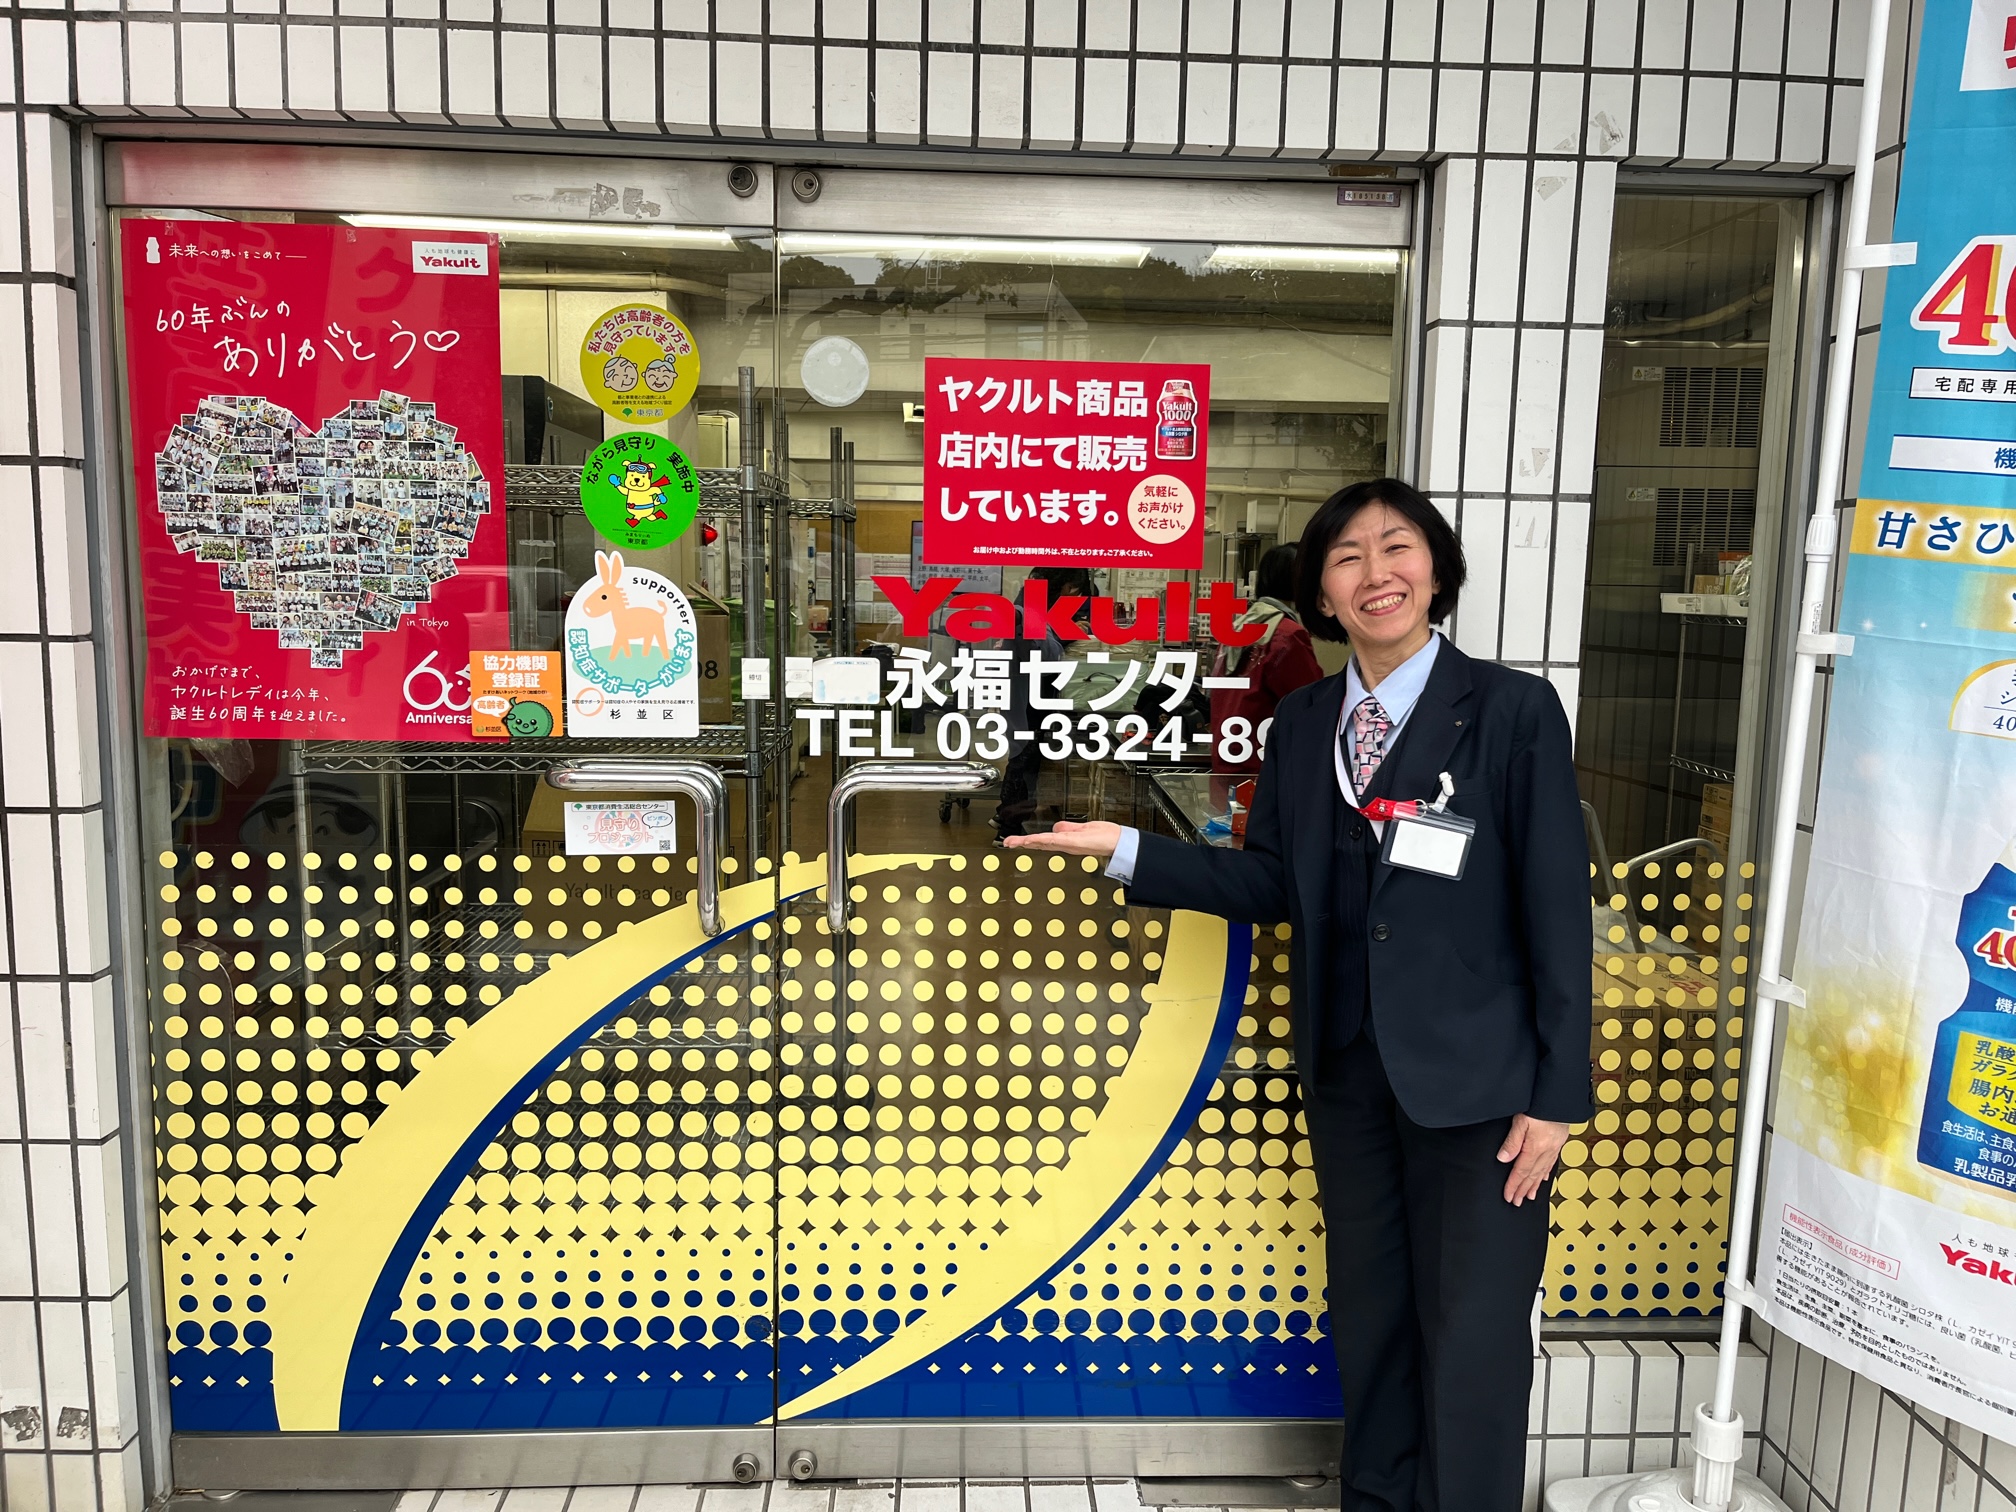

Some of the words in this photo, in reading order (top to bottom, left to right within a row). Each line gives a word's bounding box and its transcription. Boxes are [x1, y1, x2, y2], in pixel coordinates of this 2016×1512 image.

[168, 242, 283, 261] 未来への想いをこめて
[424, 247, 475, 255] 人も地球も健康に
[419, 255, 481, 269] Yakult
[1918, 243, 2016, 347] 4
[155, 295, 291, 334] 60年ぶんの
[587, 309, 691, 355] 私たちは高齢者の方を
[602, 324, 676, 356] 見守っています
[213, 318, 417, 379] ありがとう
[1935, 376, 2016, 395] 宅配専用
[938, 376, 1149, 419] ヤクルト商品
[1162, 401, 1192, 411] Yakult
[636, 408, 664, 417] 東京都
[1162, 410, 1192, 421] 1000
[585, 436, 657, 485] ながら見守り
[937, 431, 1148, 473] 店内にて販売
[1994, 446, 2016, 469] 機
[666, 451, 695, 493] 実施中
[1143, 485, 1179, 498] 気軽に
[940, 487, 1120, 527] しています。
[1137, 502, 1184, 514] お声がけ
[1137, 517, 1187, 531] ください。
[1877, 511, 2016, 555] 甘さひ
[632, 576, 690, 625] supporter
[870, 576, 1269, 647] Yakult
[406, 617, 416, 628] in
[418, 616, 450, 630] Tokyo
[171, 664, 261, 679] おかげさまで、
[482, 654, 548, 671] 協力機関
[568, 628, 695, 699] 認知症サポーターがいます
[492, 672, 541, 688] 登録証
[885, 646, 1251, 712] 永福センター
[170, 684, 331, 704] ヤクルトレディは今年、
[169, 704, 348, 723] 誕生60周年を迎えました。
[477, 699, 506, 710] 高齢者
[609, 708, 674, 720] 杉並区
[795, 709, 915, 758] TEL
[585, 803, 665, 811] 東京都消費生活総合センター
[600, 817, 640, 832] 見守り
[587, 831, 654, 844] プロジェクト
[1995, 997, 2016, 1015] 機
[1978, 1147, 2016, 1169] 食事の
[1951, 1233, 2016, 1258] 人も地球
[1939, 1242, 2016, 1287] Yak
